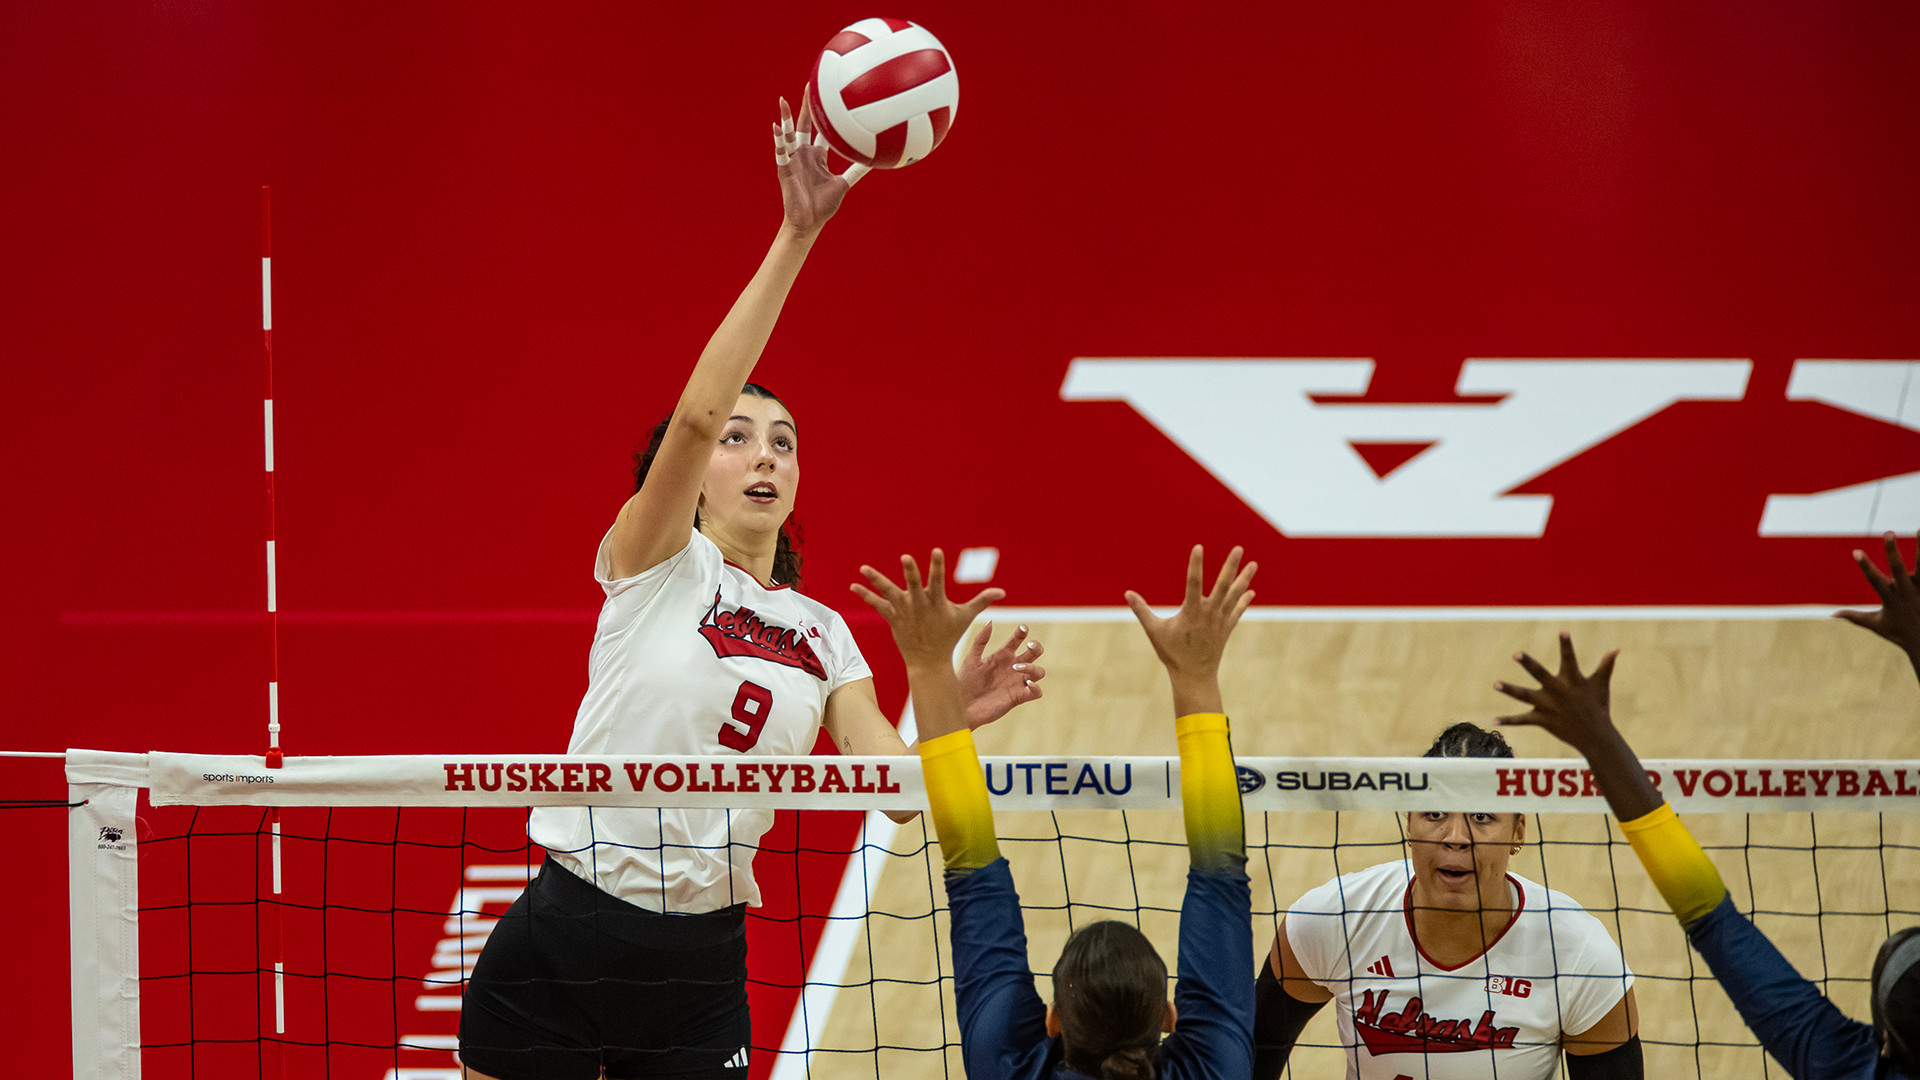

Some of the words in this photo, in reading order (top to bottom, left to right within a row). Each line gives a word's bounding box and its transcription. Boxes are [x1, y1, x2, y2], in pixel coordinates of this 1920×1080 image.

[699, 584, 824, 675] Nebrask
[718, 680, 773, 753] 9
[203, 773, 234, 782] sports
[444, 763, 613, 792] HUSKER
[624, 763, 900, 793] VOLLEYBALL
[985, 763, 1132, 796] UTEAU
[1276, 772, 1429, 791] SUBARU
[1496, 769, 1663, 797] HUSK
[1673, 769, 1920, 798] VOLLEYBAL
[1356, 989, 1520, 1052] Nebraska
